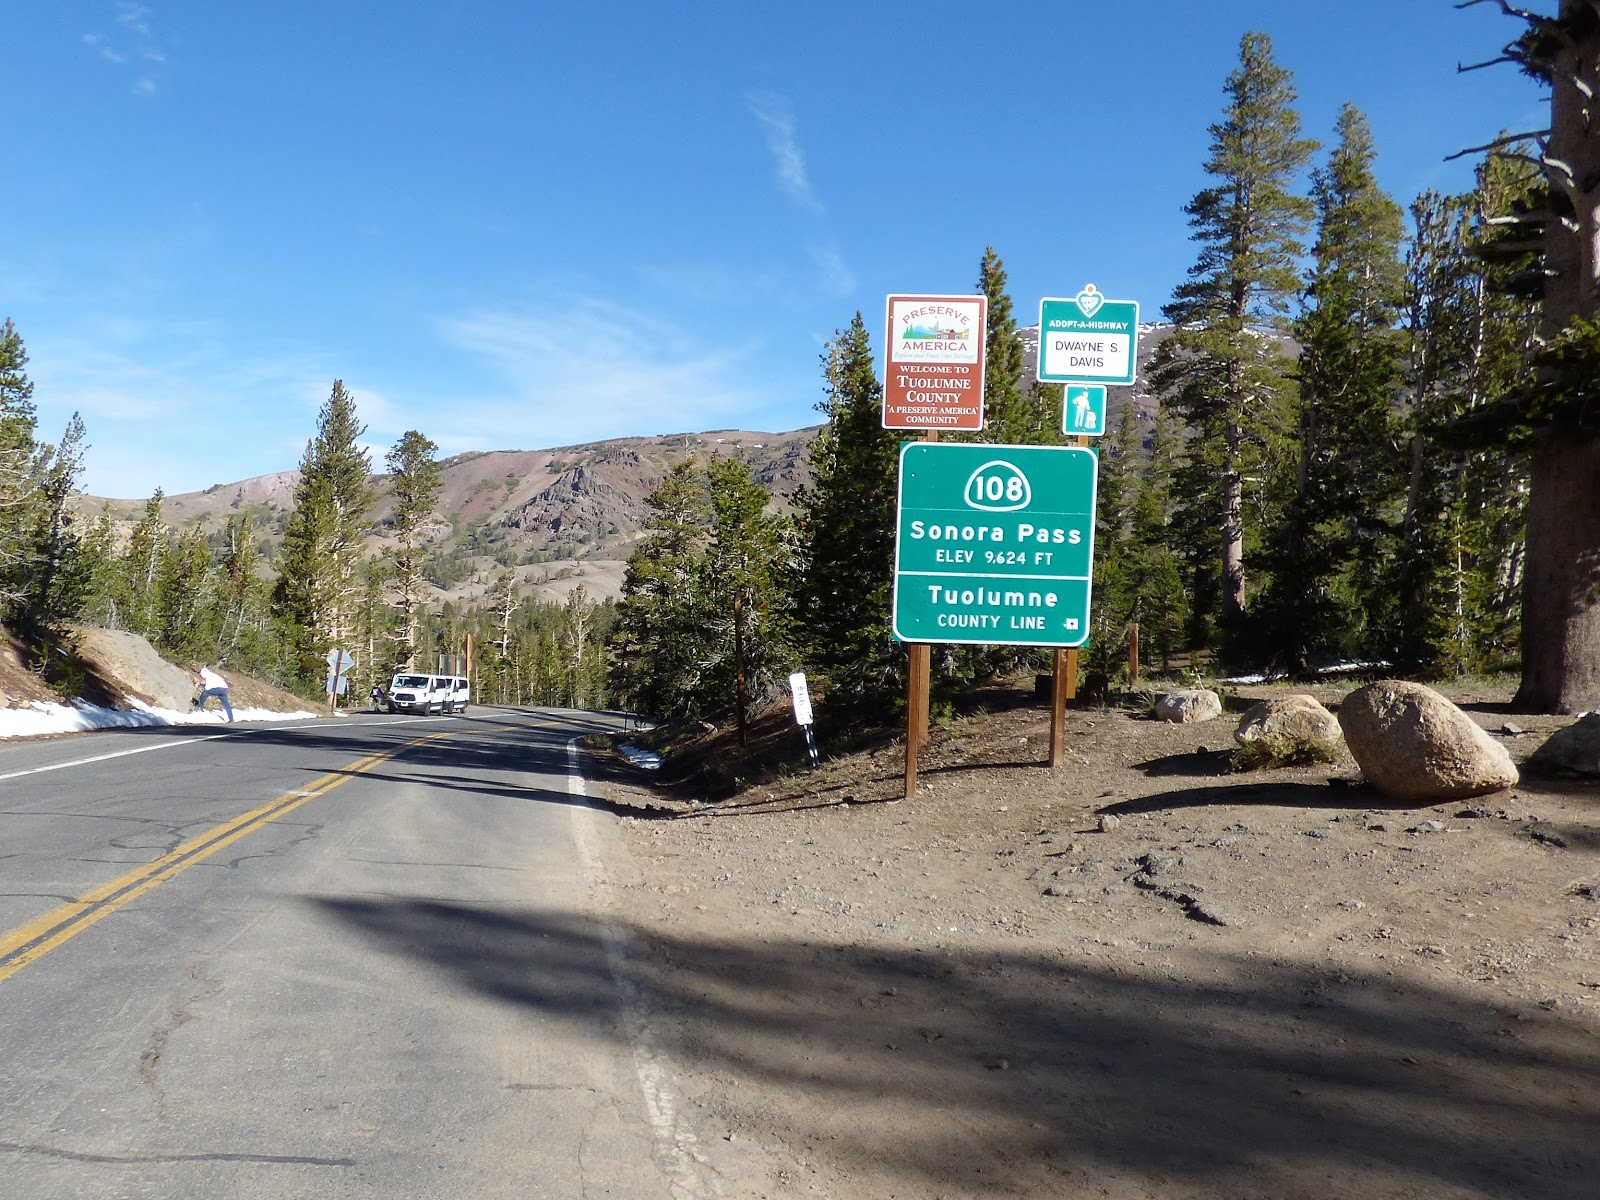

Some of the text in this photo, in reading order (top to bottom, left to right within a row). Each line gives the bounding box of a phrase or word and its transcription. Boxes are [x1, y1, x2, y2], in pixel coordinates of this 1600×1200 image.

[902, 306, 970, 326] PRESERVE
[1049, 319, 1128, 330] ADOPT-A-HIGHWAY
[902, 341, 968, 351] AMERICA
[1055, 341, 1121, 353] DWAYNE S.
[1070, 357, 1104, 367] DAVIS
[900, 365, 970, 374] WELCOME TO
[897, 375, 972, 389] TUOLUMNE
[906, 390, 962, 403] COUNTY
[897, 406, 937, 414] PRESERVE
[906, 415, 960, 424] COMMUNITY
[976, 475, 1023, 501] 108
[910, 520, 1082, 545] Sonora Pass
[936, 549, 974, 564] ELEV
[1034, 552, 1053, 566] FT
[928, 585, 1058, 608] Tuolumne
[938, 613, 1046, 630] COUNTY LINE
